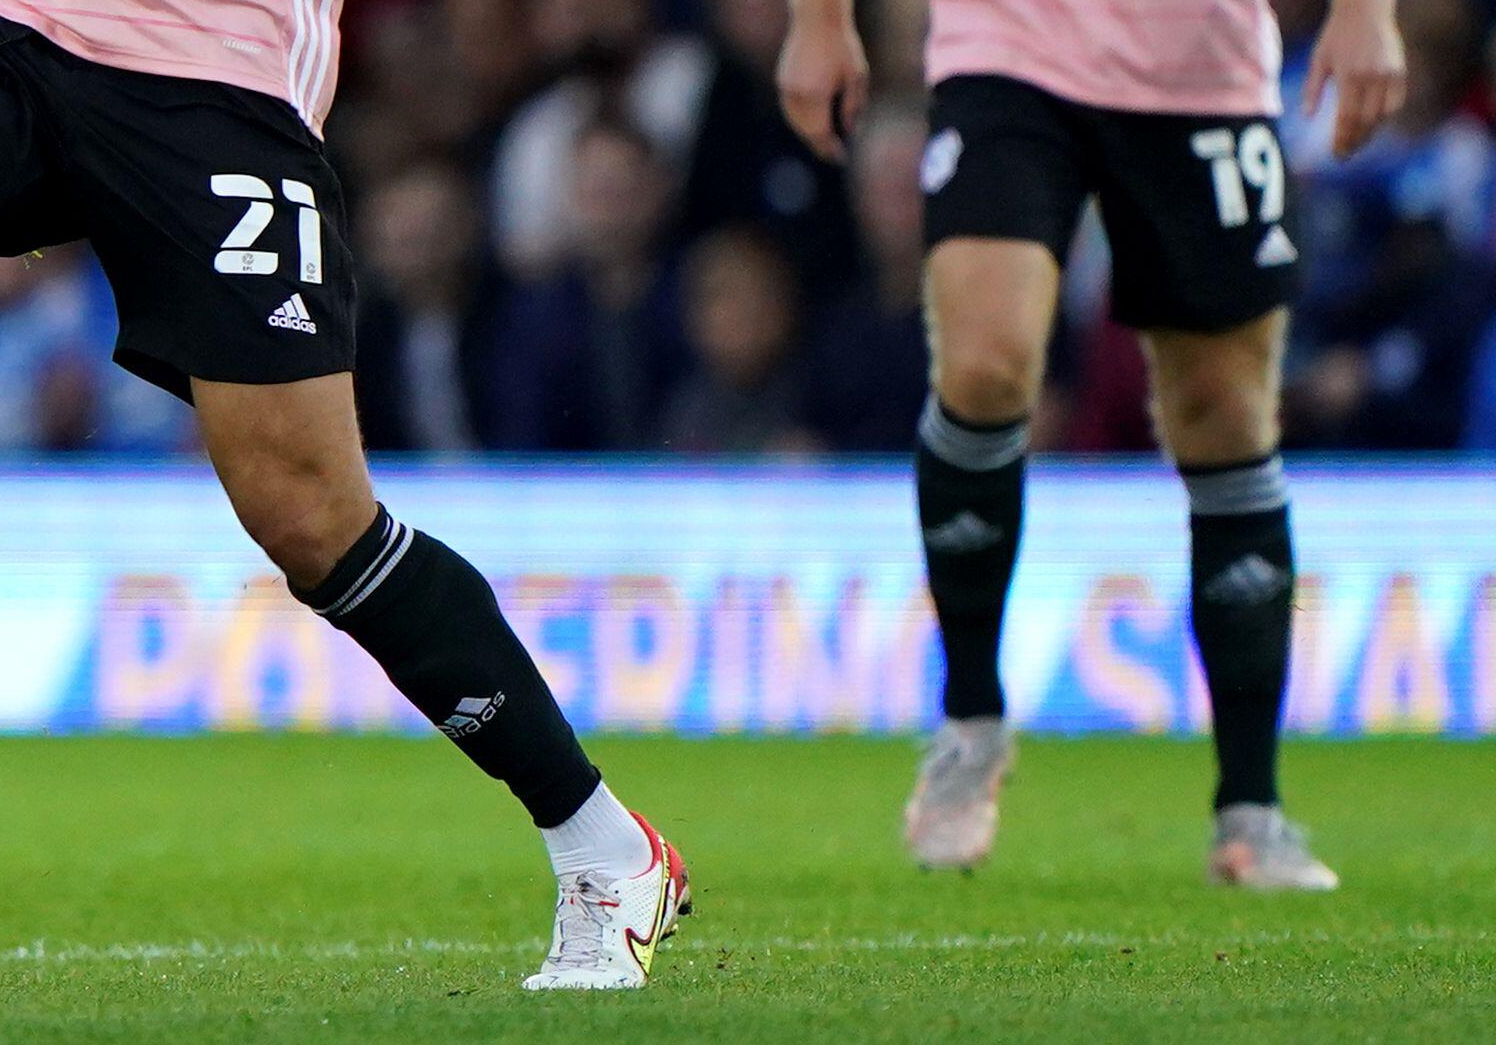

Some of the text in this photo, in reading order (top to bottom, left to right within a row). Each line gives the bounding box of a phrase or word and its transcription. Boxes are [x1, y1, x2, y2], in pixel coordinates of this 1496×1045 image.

[210, 173, 323, 285] 21
[1189, 122, 1287, 229] 19
[267, 314, 317, 335] adidas
